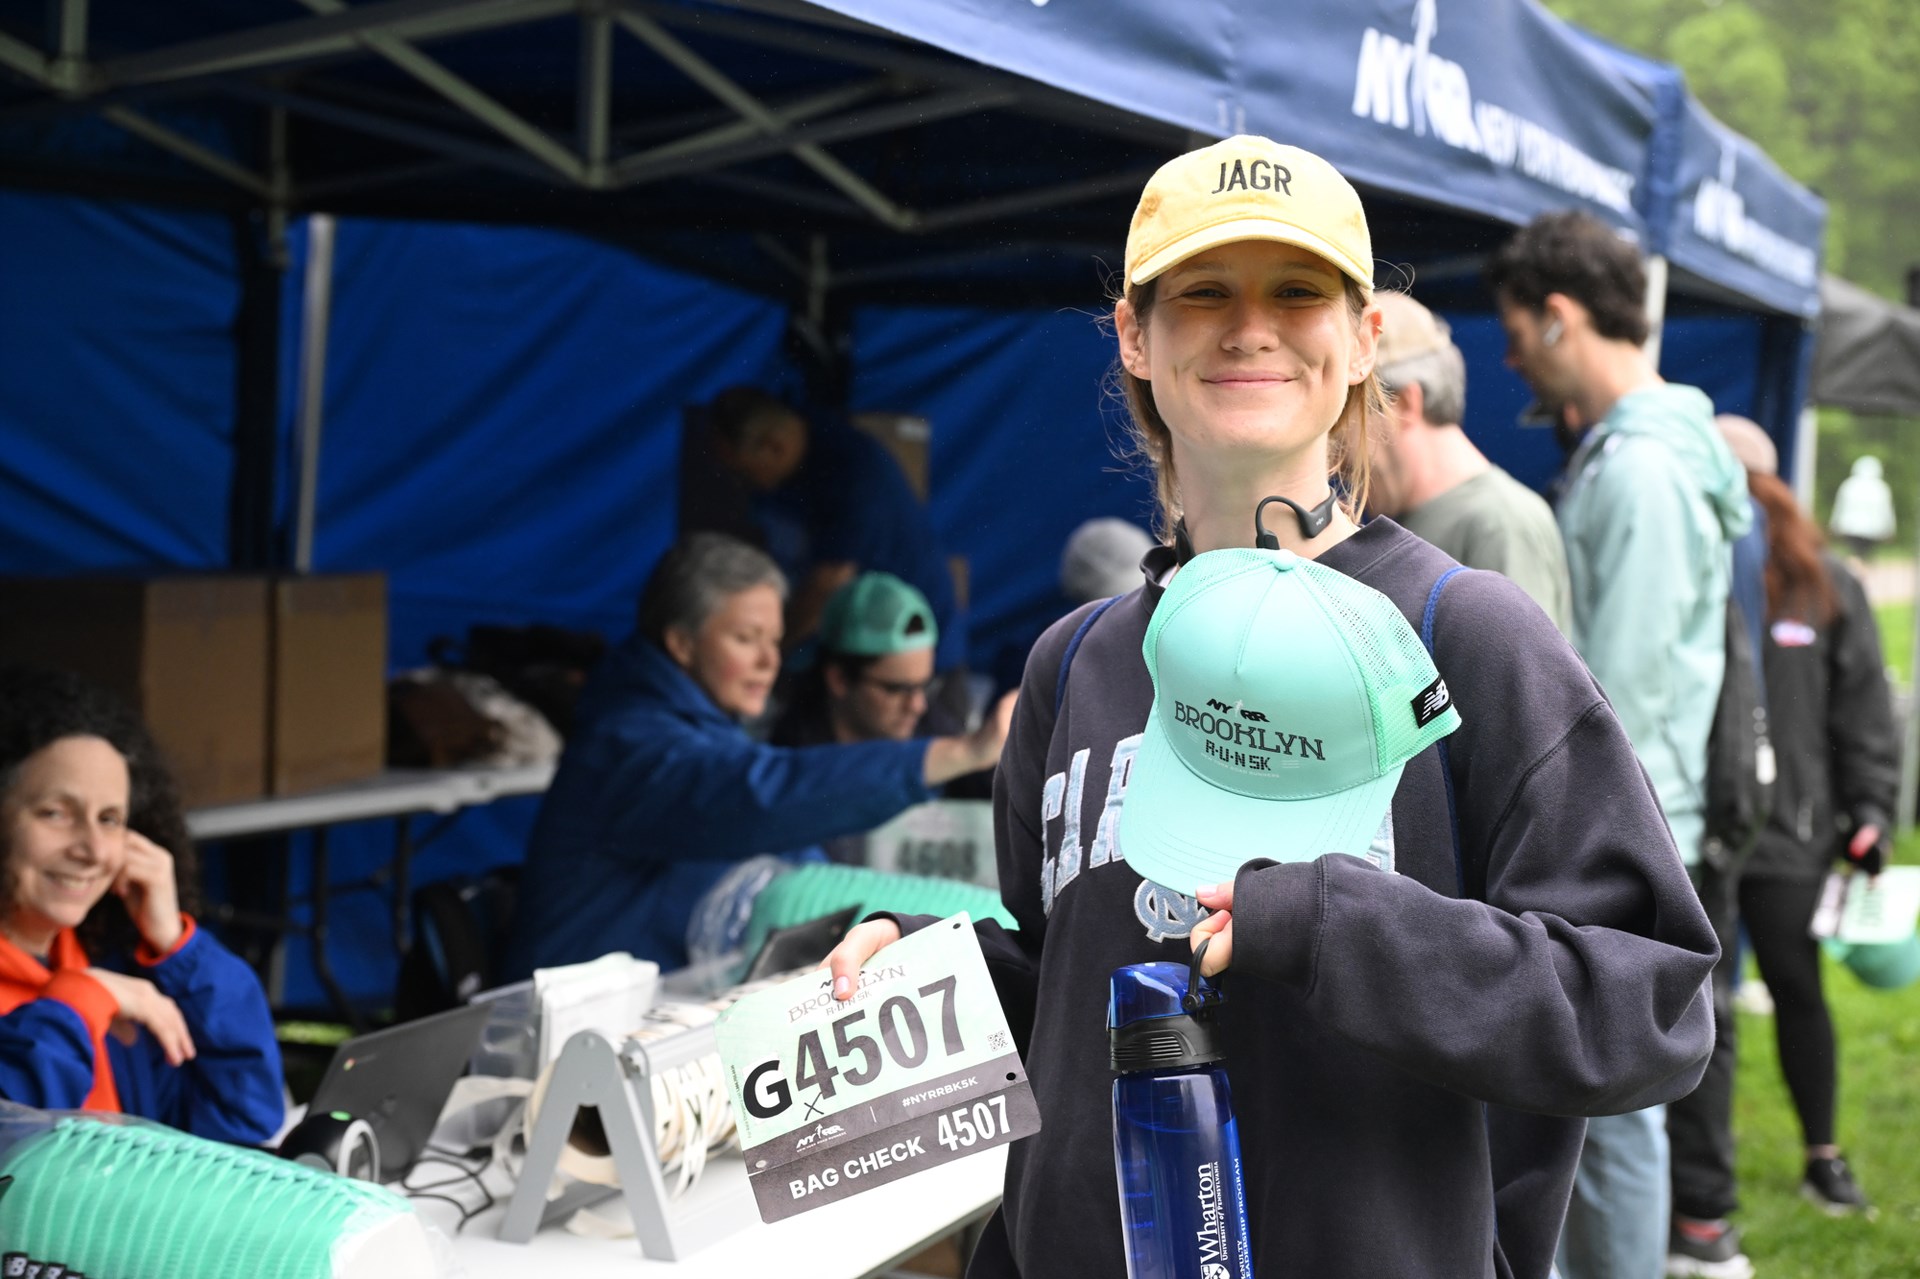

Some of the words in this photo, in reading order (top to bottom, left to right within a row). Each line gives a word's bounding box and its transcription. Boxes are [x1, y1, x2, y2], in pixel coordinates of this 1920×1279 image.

[1211, 158, 1292, 197] JAGR
[1174, 700, 1326, 761] BROOKLYN
[1206, 698, 1270, 723] NYRR
[788, 965, 906, 1023] BROLYN
[743, 1060, 793, 1119] G
[795, 974, 965, 1101] 4507
[902, 1076, 978, 1108] #NYRRBK5K
[789, 1168, 840, 1200] BAG
[843, 1136, 926, 1180] CHECK
[937, 1095, 1011, 1151] 4507
[1196, 1162, 1220, 1264] Wharton
[1234, 1158, 1245, 1214] PROGRAM
